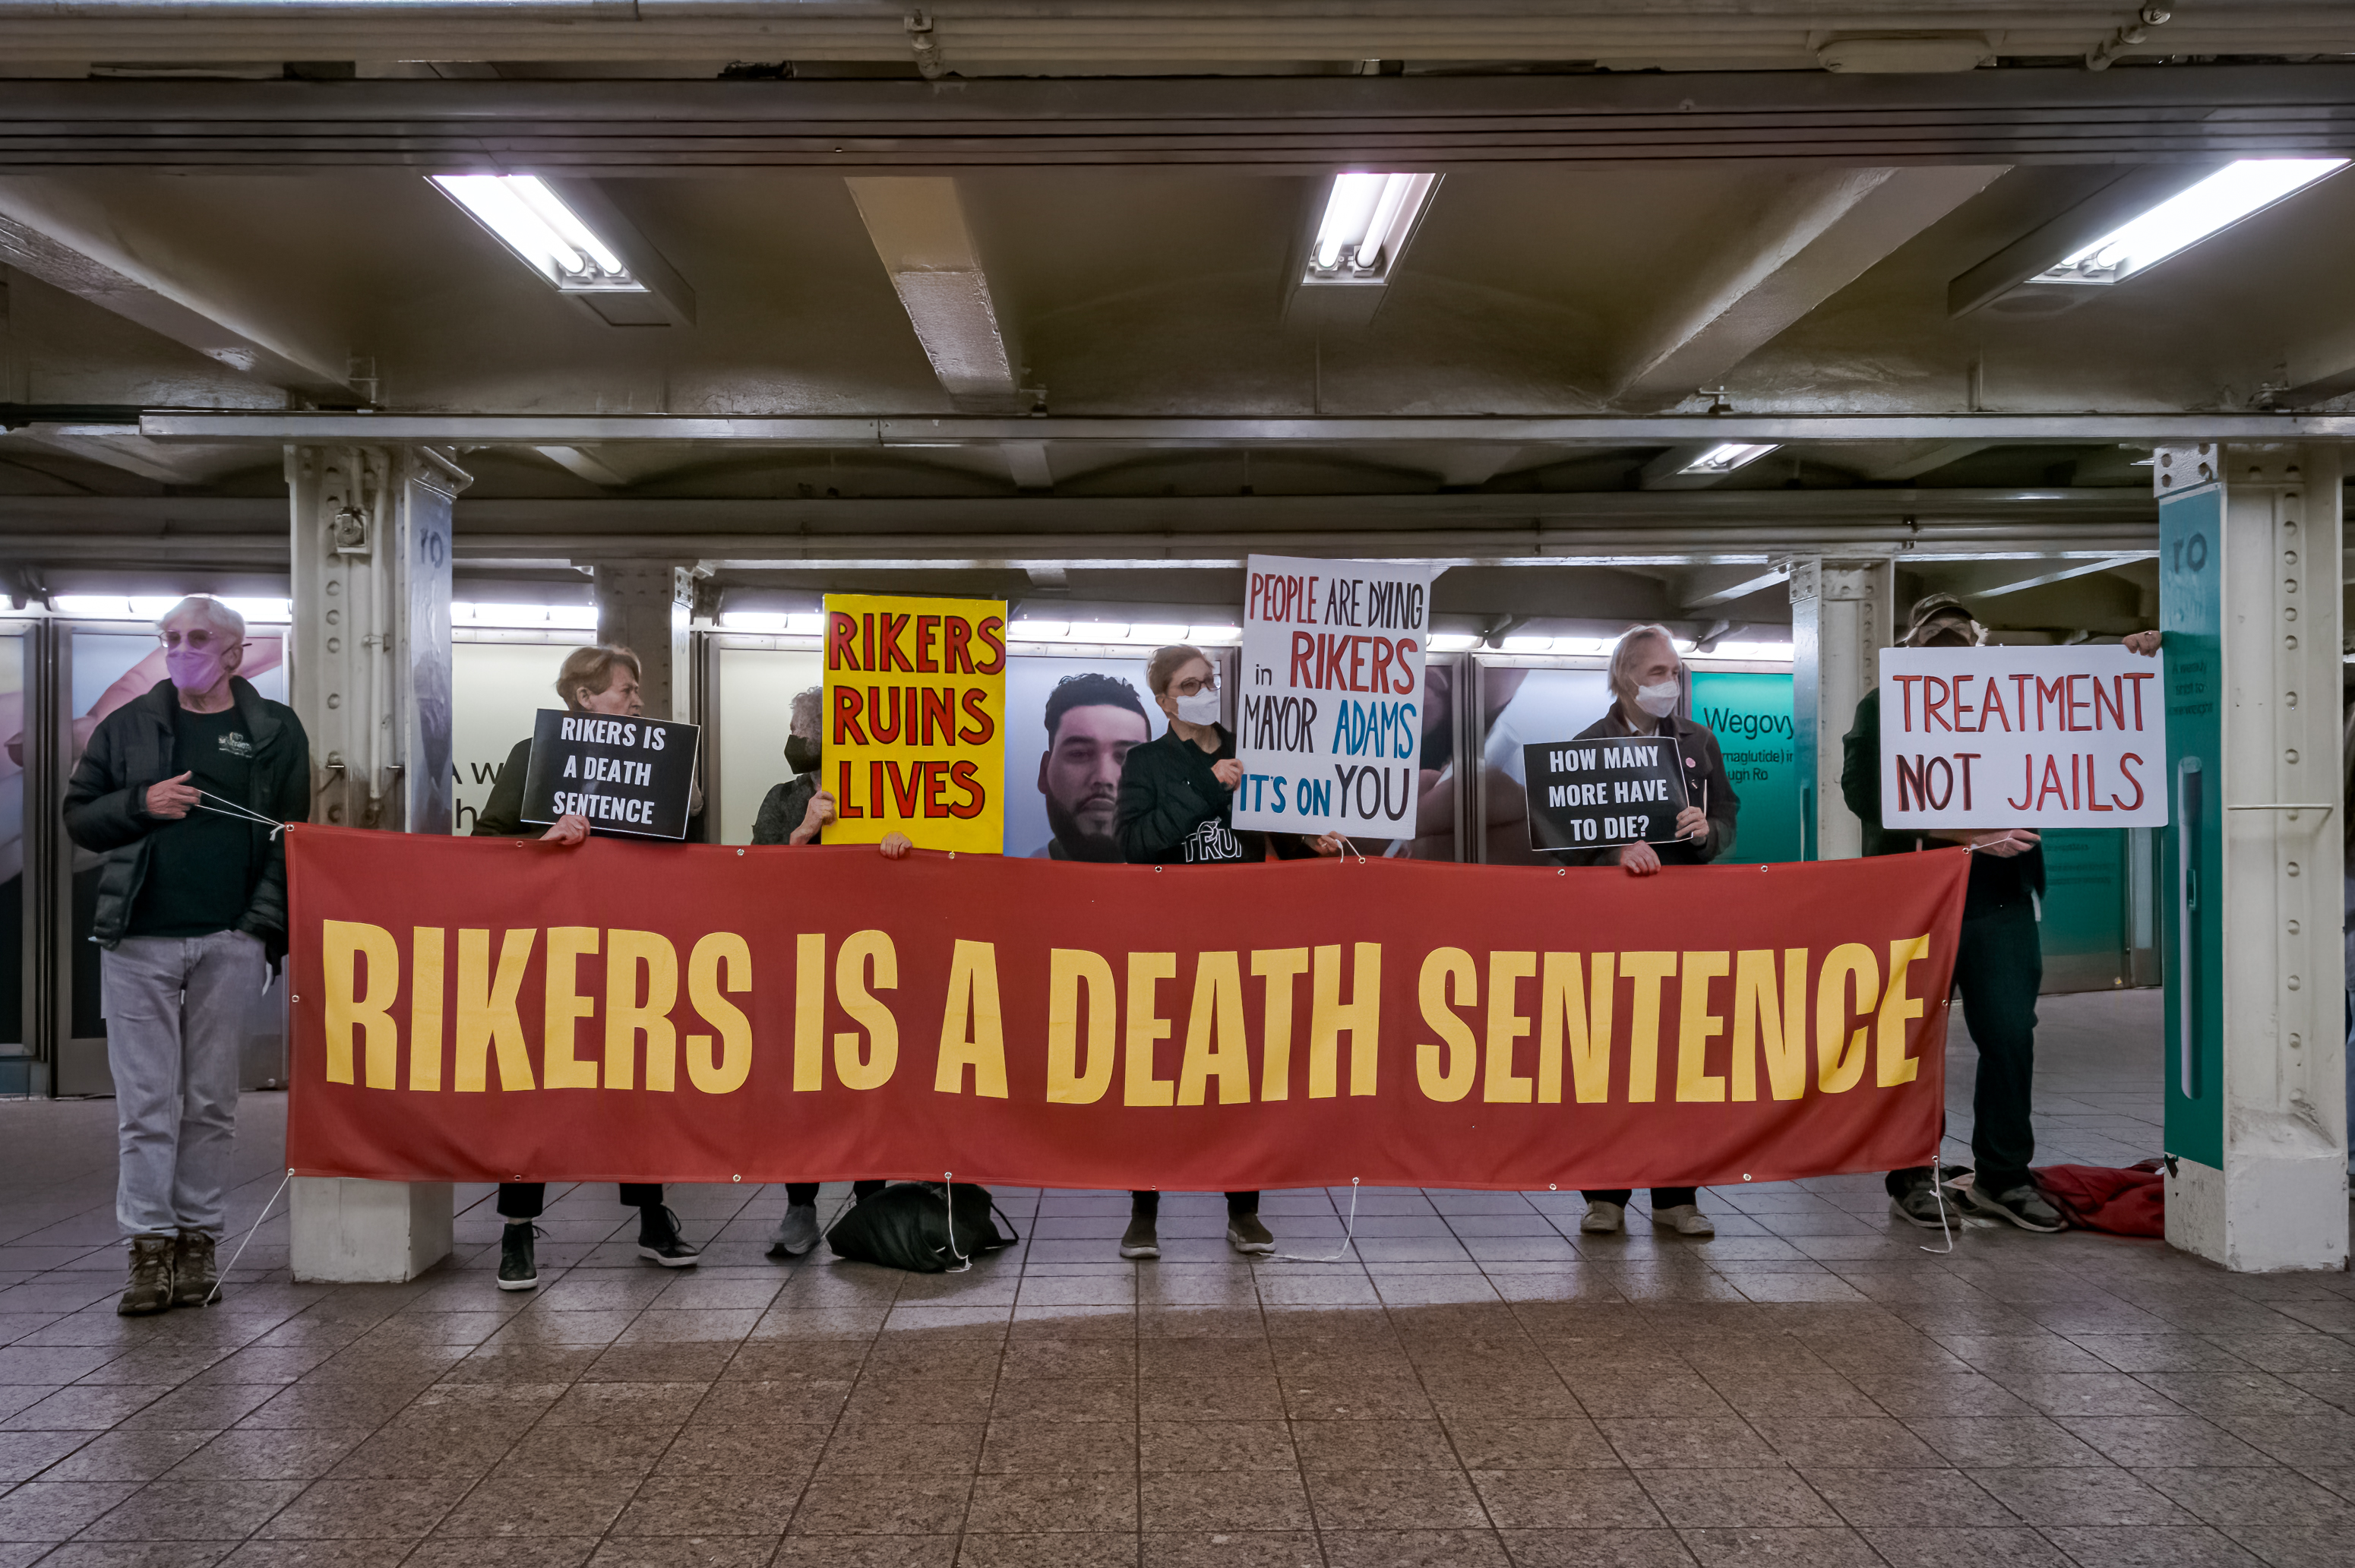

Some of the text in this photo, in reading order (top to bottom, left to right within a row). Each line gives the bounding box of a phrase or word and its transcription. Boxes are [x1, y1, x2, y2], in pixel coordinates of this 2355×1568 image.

[1250, 573, 1424, 630] PEOPLE ARE DYING
[829, 611, 1006, 675] RIKERS
[1256, 631, 1418, 695] in RIKERS
[833, 685, 994, 746] RUINS
[1243, 694, 1417, 759] MAYOR ADAMS
[1704, 707, 1794, 740] Wegovy
[1892, 672, 2154, 733] TREATMENT
[561, 717, 666, 751] RIKERS IS
[1550, 745, 1658, 773] HOW MANY
[563, 754, 652, 786] A DEATH
[839, 760, 985, 820] LIVES
[1240, 763, 1410, 821] IT'S ON YOU
[1549, 779, 1669, 808] MORE HAVE
[1895, 752, 2144, 811] NOT JAILS
[552, 791, 655, 824] SENTENCE
[1570, 815, 1649, 841] TO DIE?
[323, 919, 1930, 1106] RIKERS IS A DEATH SENTENCE
